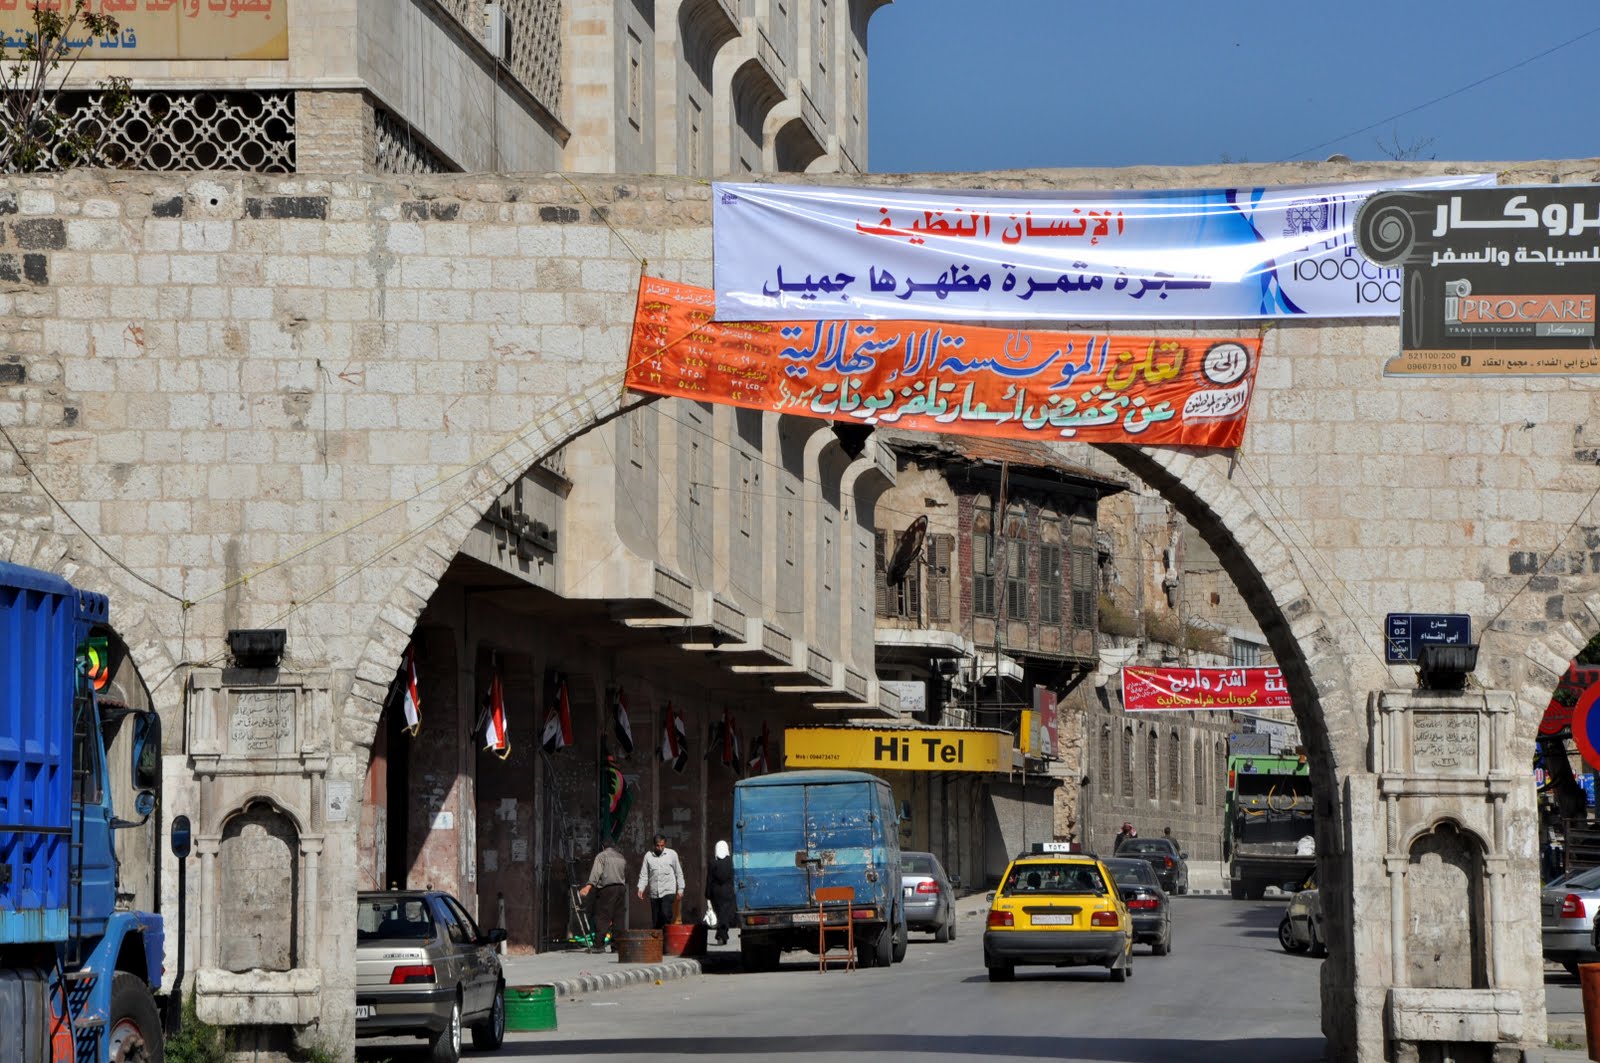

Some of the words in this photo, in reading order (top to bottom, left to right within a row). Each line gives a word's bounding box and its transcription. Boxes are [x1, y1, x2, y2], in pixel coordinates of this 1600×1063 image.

[856, 207, 992, 245] النظيف
[1432, 196, 1600, 236] روكار
[1431, 247, 1510, 266] والسفر
[1514, 246, 1600, 265] لسياحة
[763, 264, 856, 300] جميل
[869, 264, 992, 300] مظهرها
[1462, 298, 1594, 320] PROCARE
[1105, 339, 1186, 391] تعلن
[1123, 396, 1176, 434] عن
[1430, 619, 1448, 629] شارع
[1217, 689, 1260, 706] كوبونات
[874, 737, 909, 761] Hi
[922, 738, 963, 763] Tel
